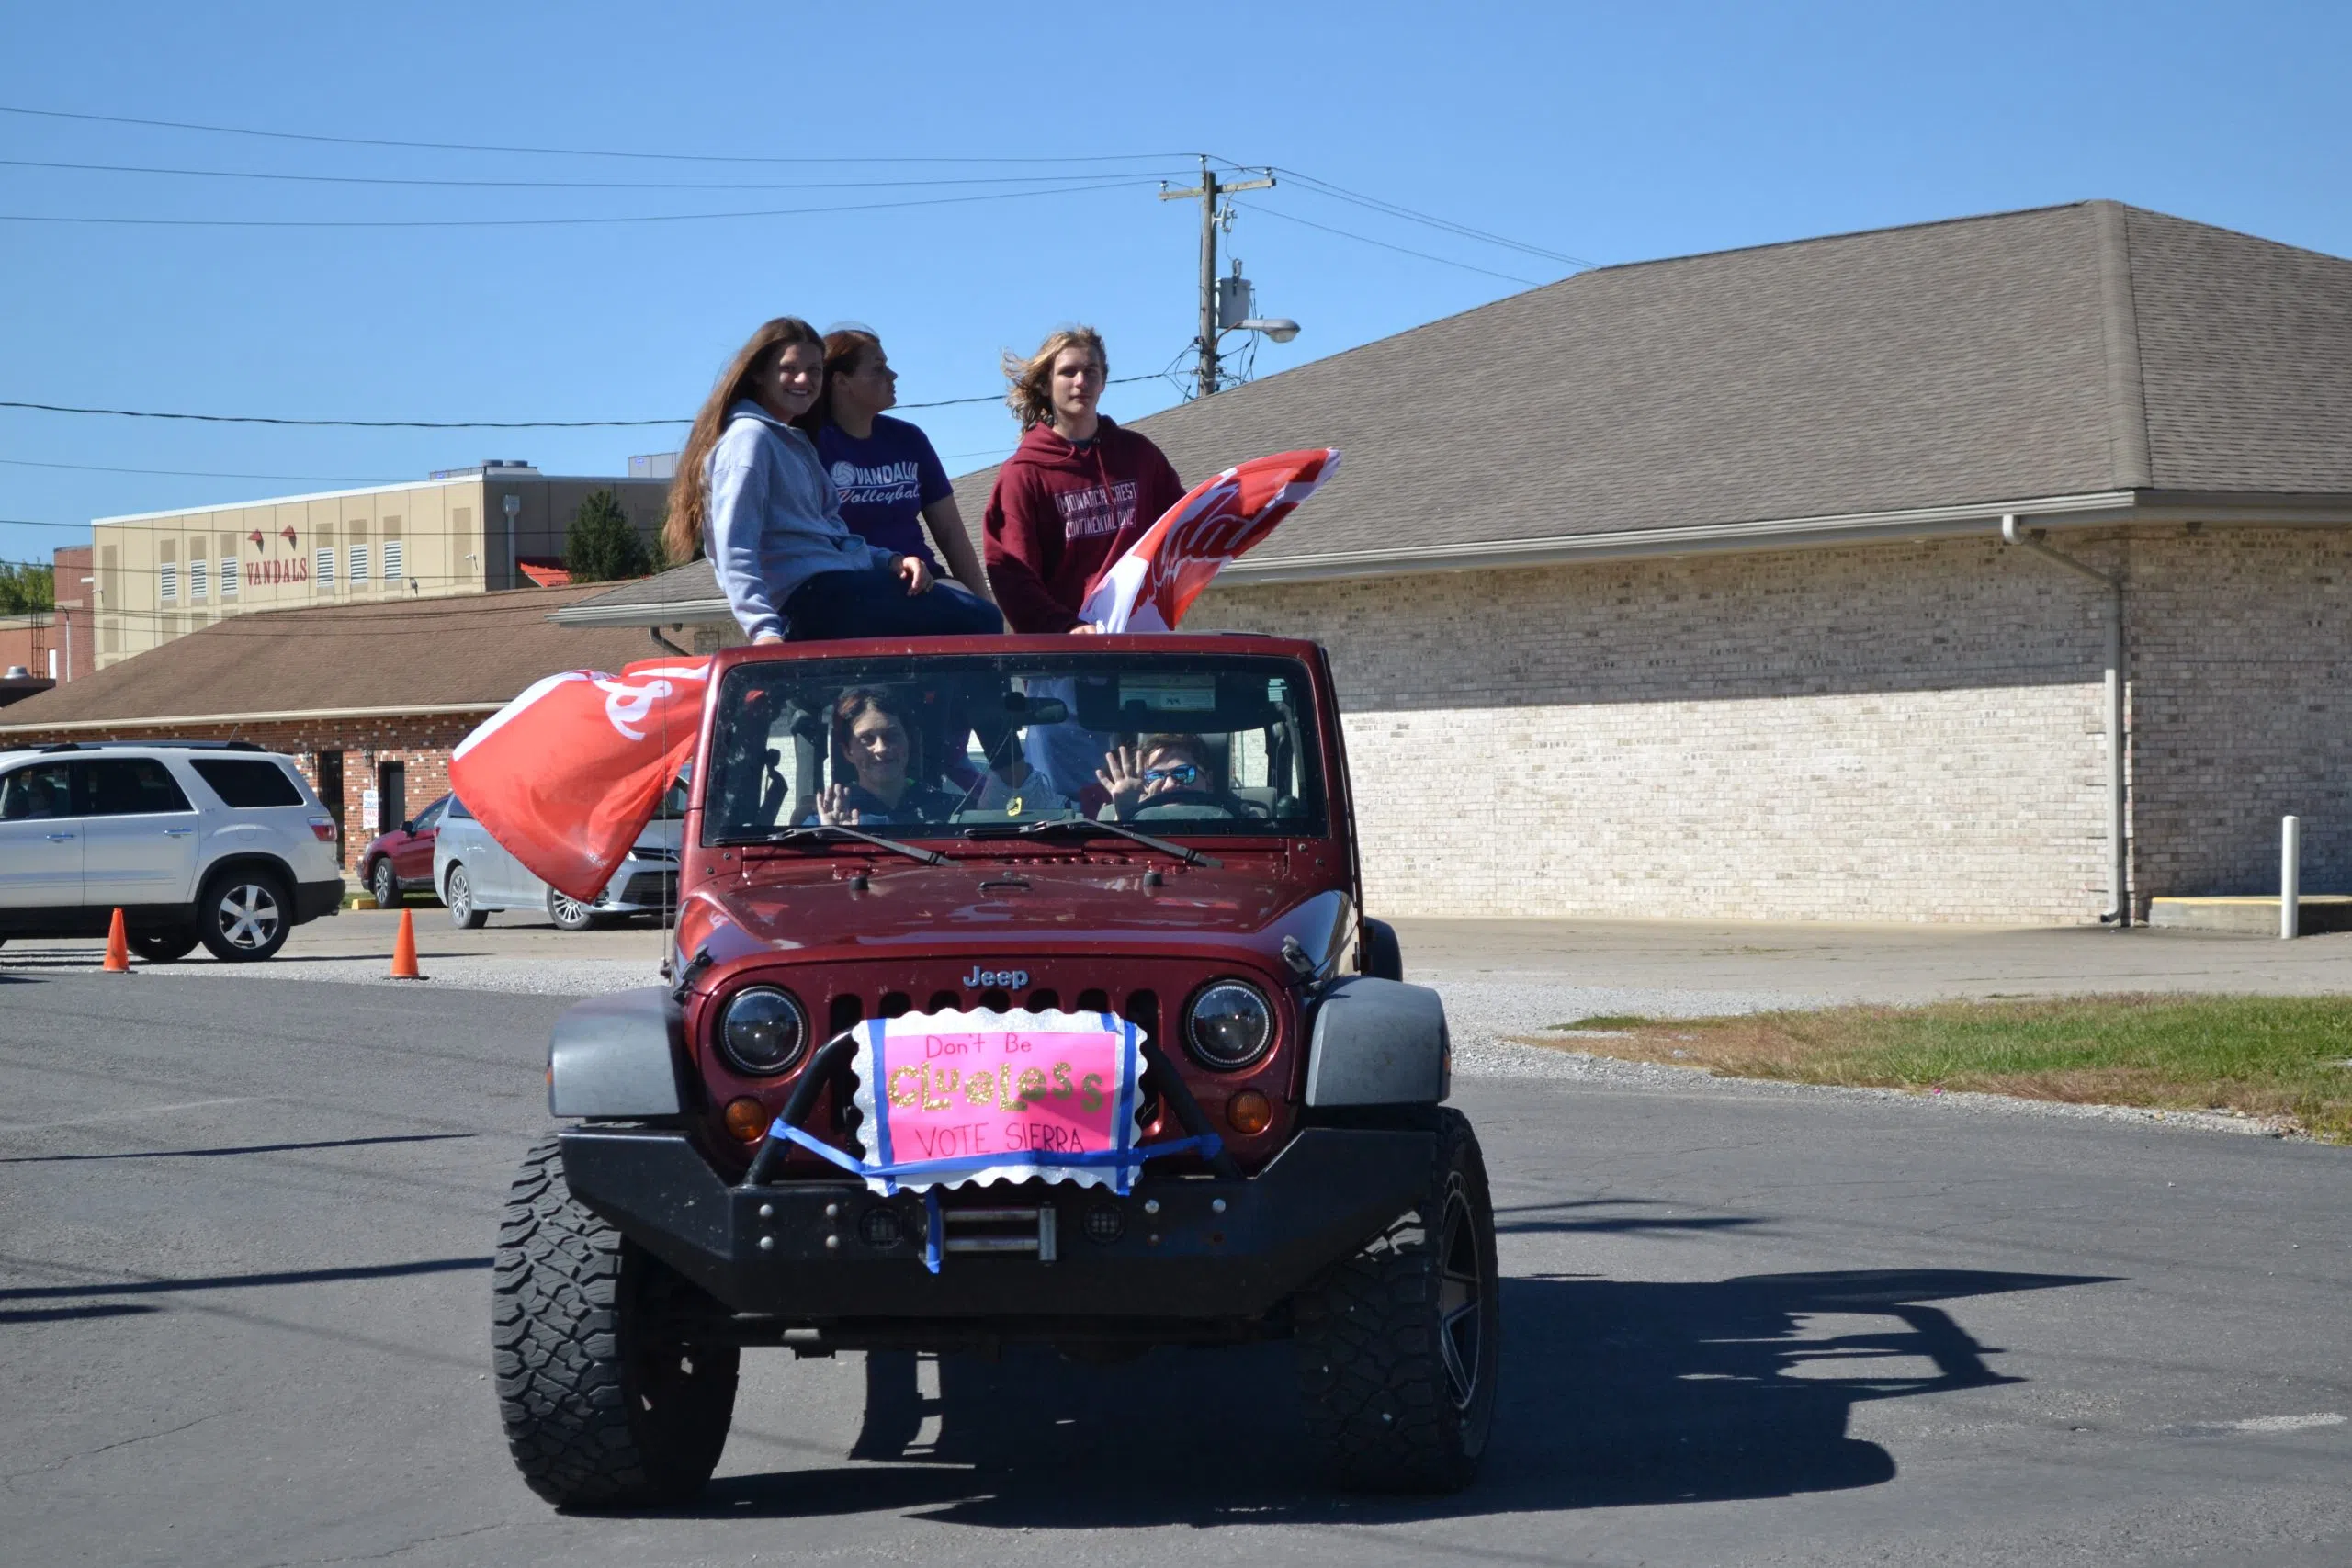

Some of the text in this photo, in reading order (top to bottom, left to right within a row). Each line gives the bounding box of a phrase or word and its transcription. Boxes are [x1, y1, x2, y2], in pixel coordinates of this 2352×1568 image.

[855, 461, 919, 485] VANDALIA
[1058, 488, 1108, 513] MONARCH
[1109, 482, 1137, 505] CREST
[1065, 513, 1117, 538] CONTINENTAL
[245, 557, 308, 586] VANDALS
[963, 965, 1029, 989] Jeep
[925, 1032, 1033, 1058] Don't Be
[915, 1122, 1086, 1158] VOTE SIERRA
